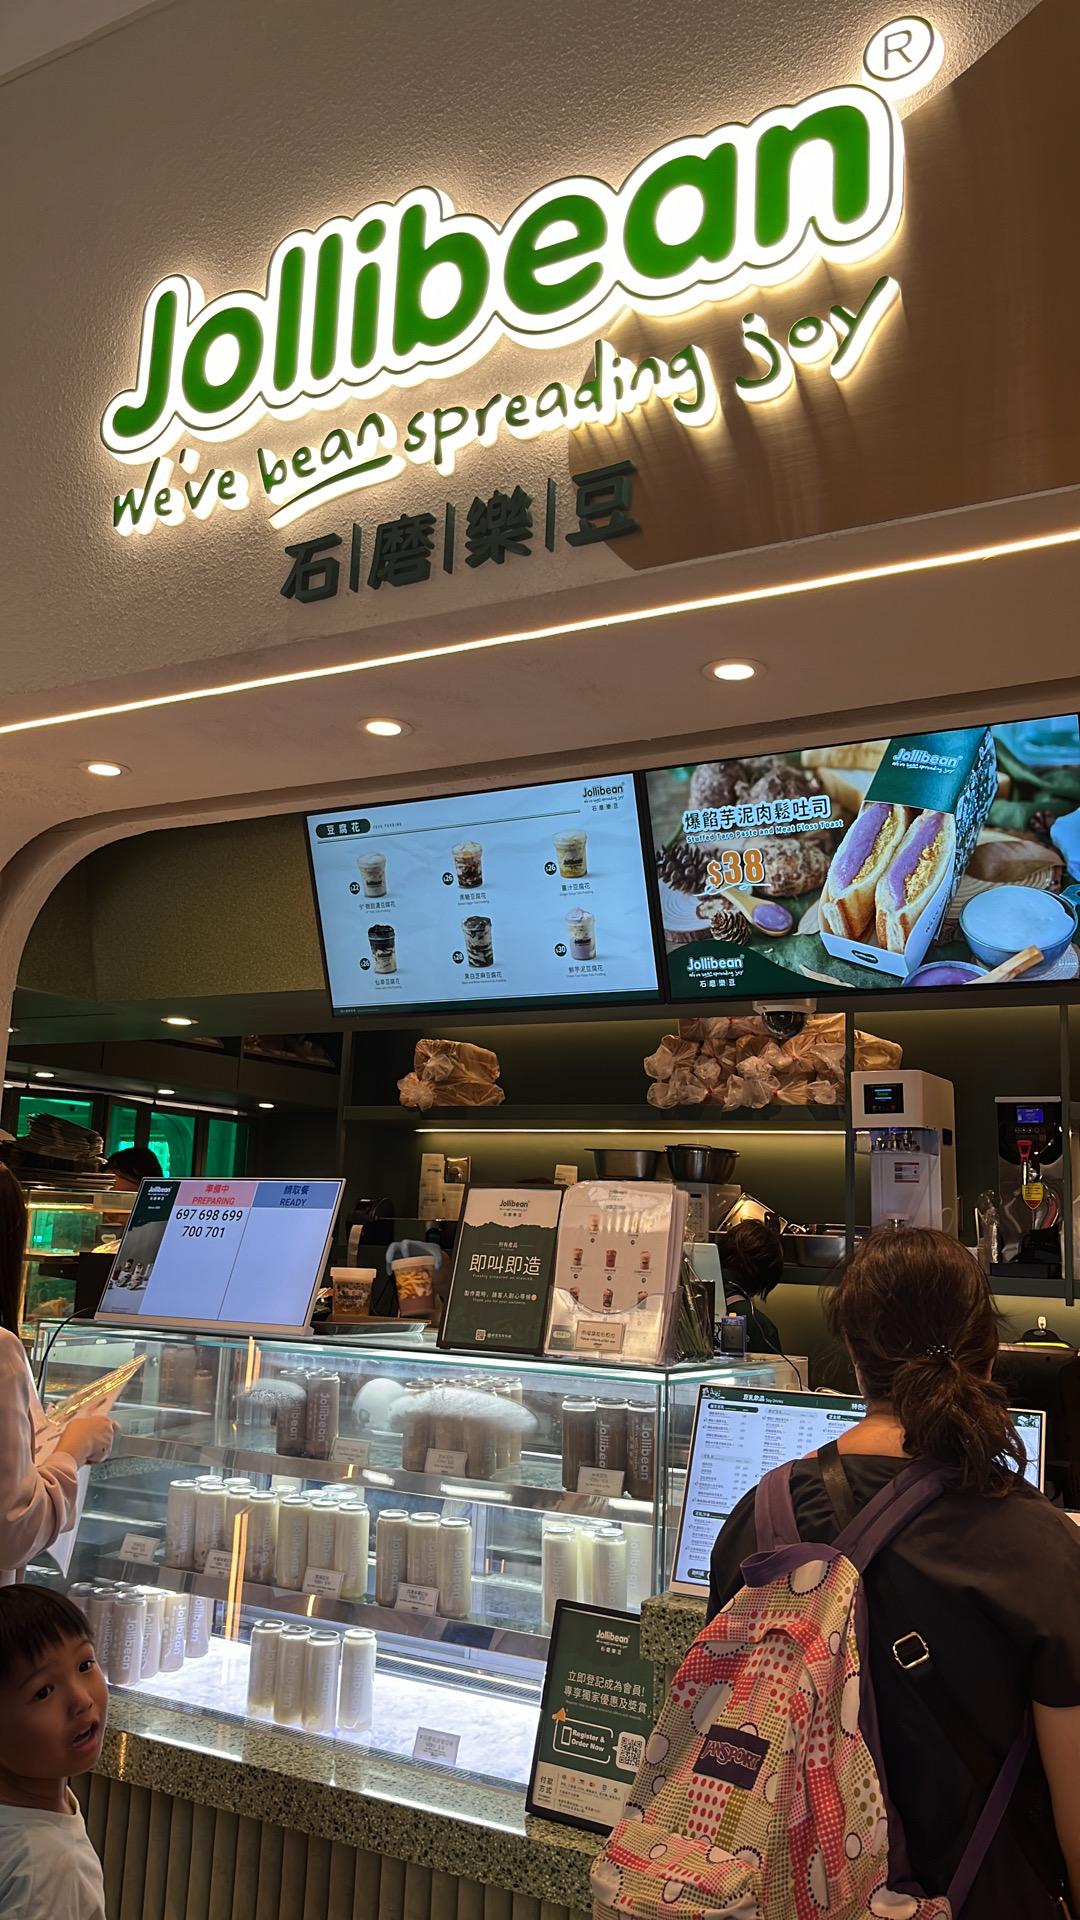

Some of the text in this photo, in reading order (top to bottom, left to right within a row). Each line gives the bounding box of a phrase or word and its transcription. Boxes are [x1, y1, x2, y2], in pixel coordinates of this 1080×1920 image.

[110, 103, 871, 442] Jollibean
[113, 275, 892, 530] We've bean spreading joy
[892, 748, 961, 768] Jollibean
[582, 785, 624, 798] Jollibean
[683, 798, 830, 831] 爆餡芋泥肉鬆吐司
[325, 821, 361, 836] 豆腐花
[686, 819, 844, 844] Stuffed Taro Paste and Meat Floss Toast
[706, 849, 765, 887] $38
[687, 957, 743, 971] Jollibean
[191, 1196, 236, 1206] PREPARING
[279, 1198, 307, 1207] READY
[499, 1200, 529, 1208] Jollibean
[176, 1209, 243, 1222] 697 698 699
[181, 1225, 225, 1239] 700 701
[468, 1254, 542, 1276] 即叫即造
[318, 1392, 331, 1441] Jollibean
[599, 1421, 610, 1468] Jollibea
[640, 1423, 653, 1480] Jollibean
[174, 1604, 187, 1655] Jollibean
[191, 1599, 205, 1642] ollibean
[122, 1618, 137, 1670] Jollibean
[596, 1629, 629, 1644] Jollibean
[567, 1668, 645, 1697] 立即登記成為會員!
[571, 1738, 605, 1752] Order Now
[572, 1729, 599, 1742] Register
